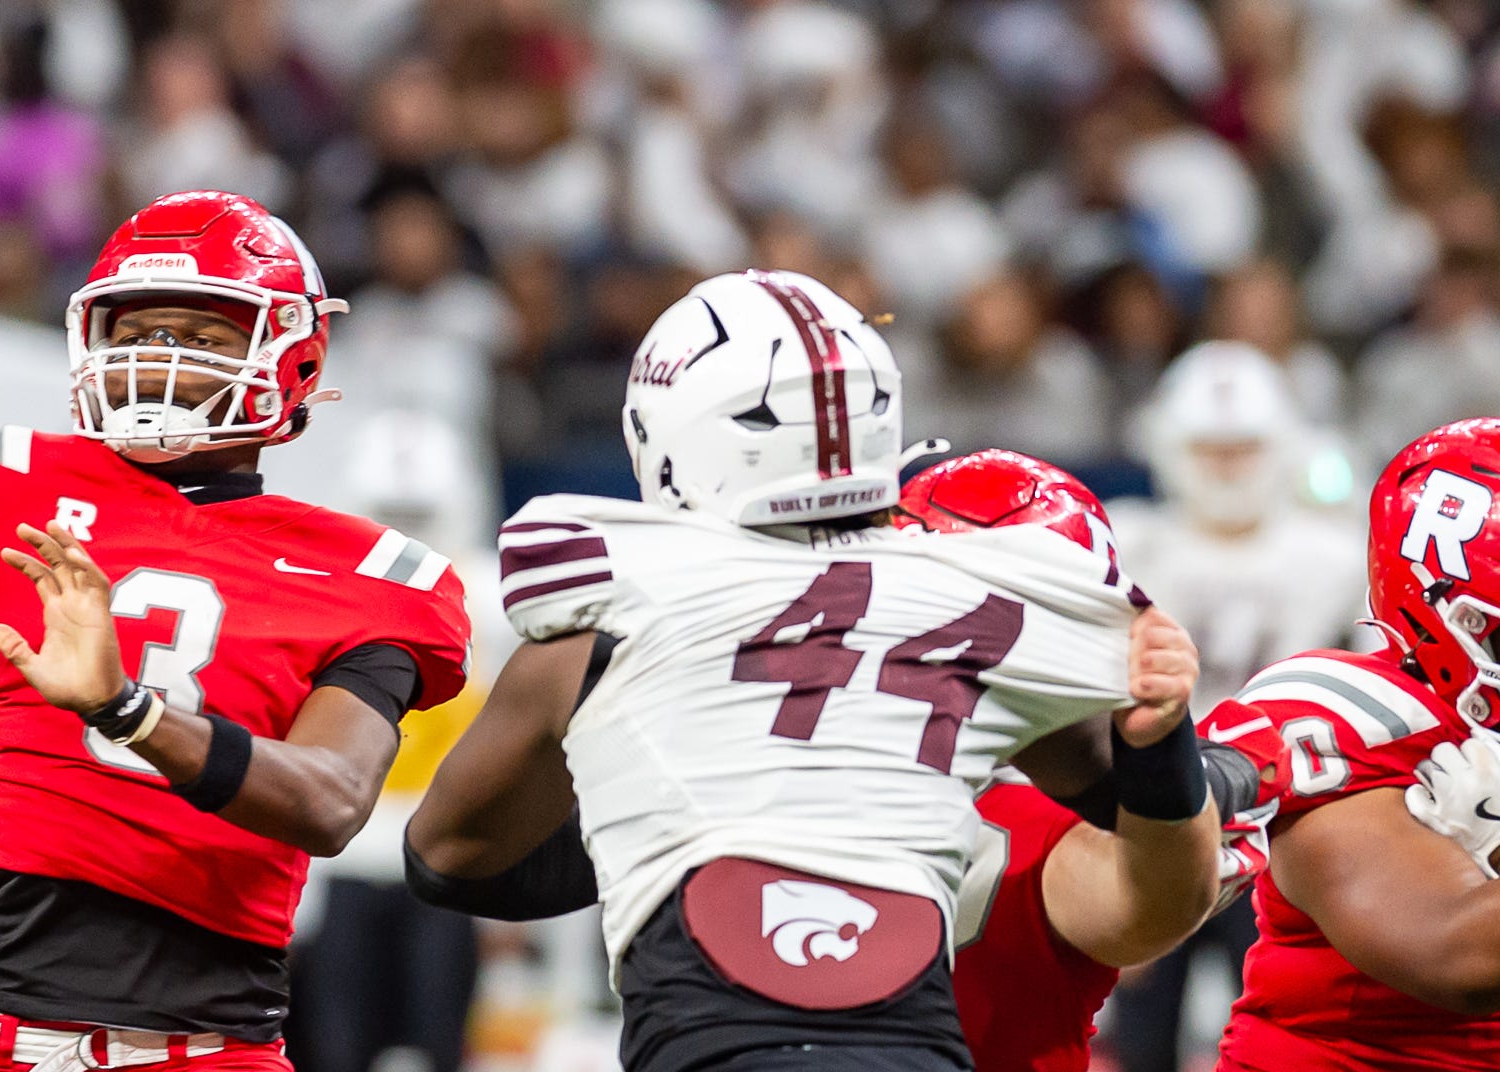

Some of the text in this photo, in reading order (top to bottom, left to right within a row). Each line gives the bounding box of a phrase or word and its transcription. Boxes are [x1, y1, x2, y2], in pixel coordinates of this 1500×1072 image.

[56, 496, 98, 542] R
[1399, 467, 1493, 582] R
[81, 567, 226, 777] 3
[731, 561, 1025, 776] 44
